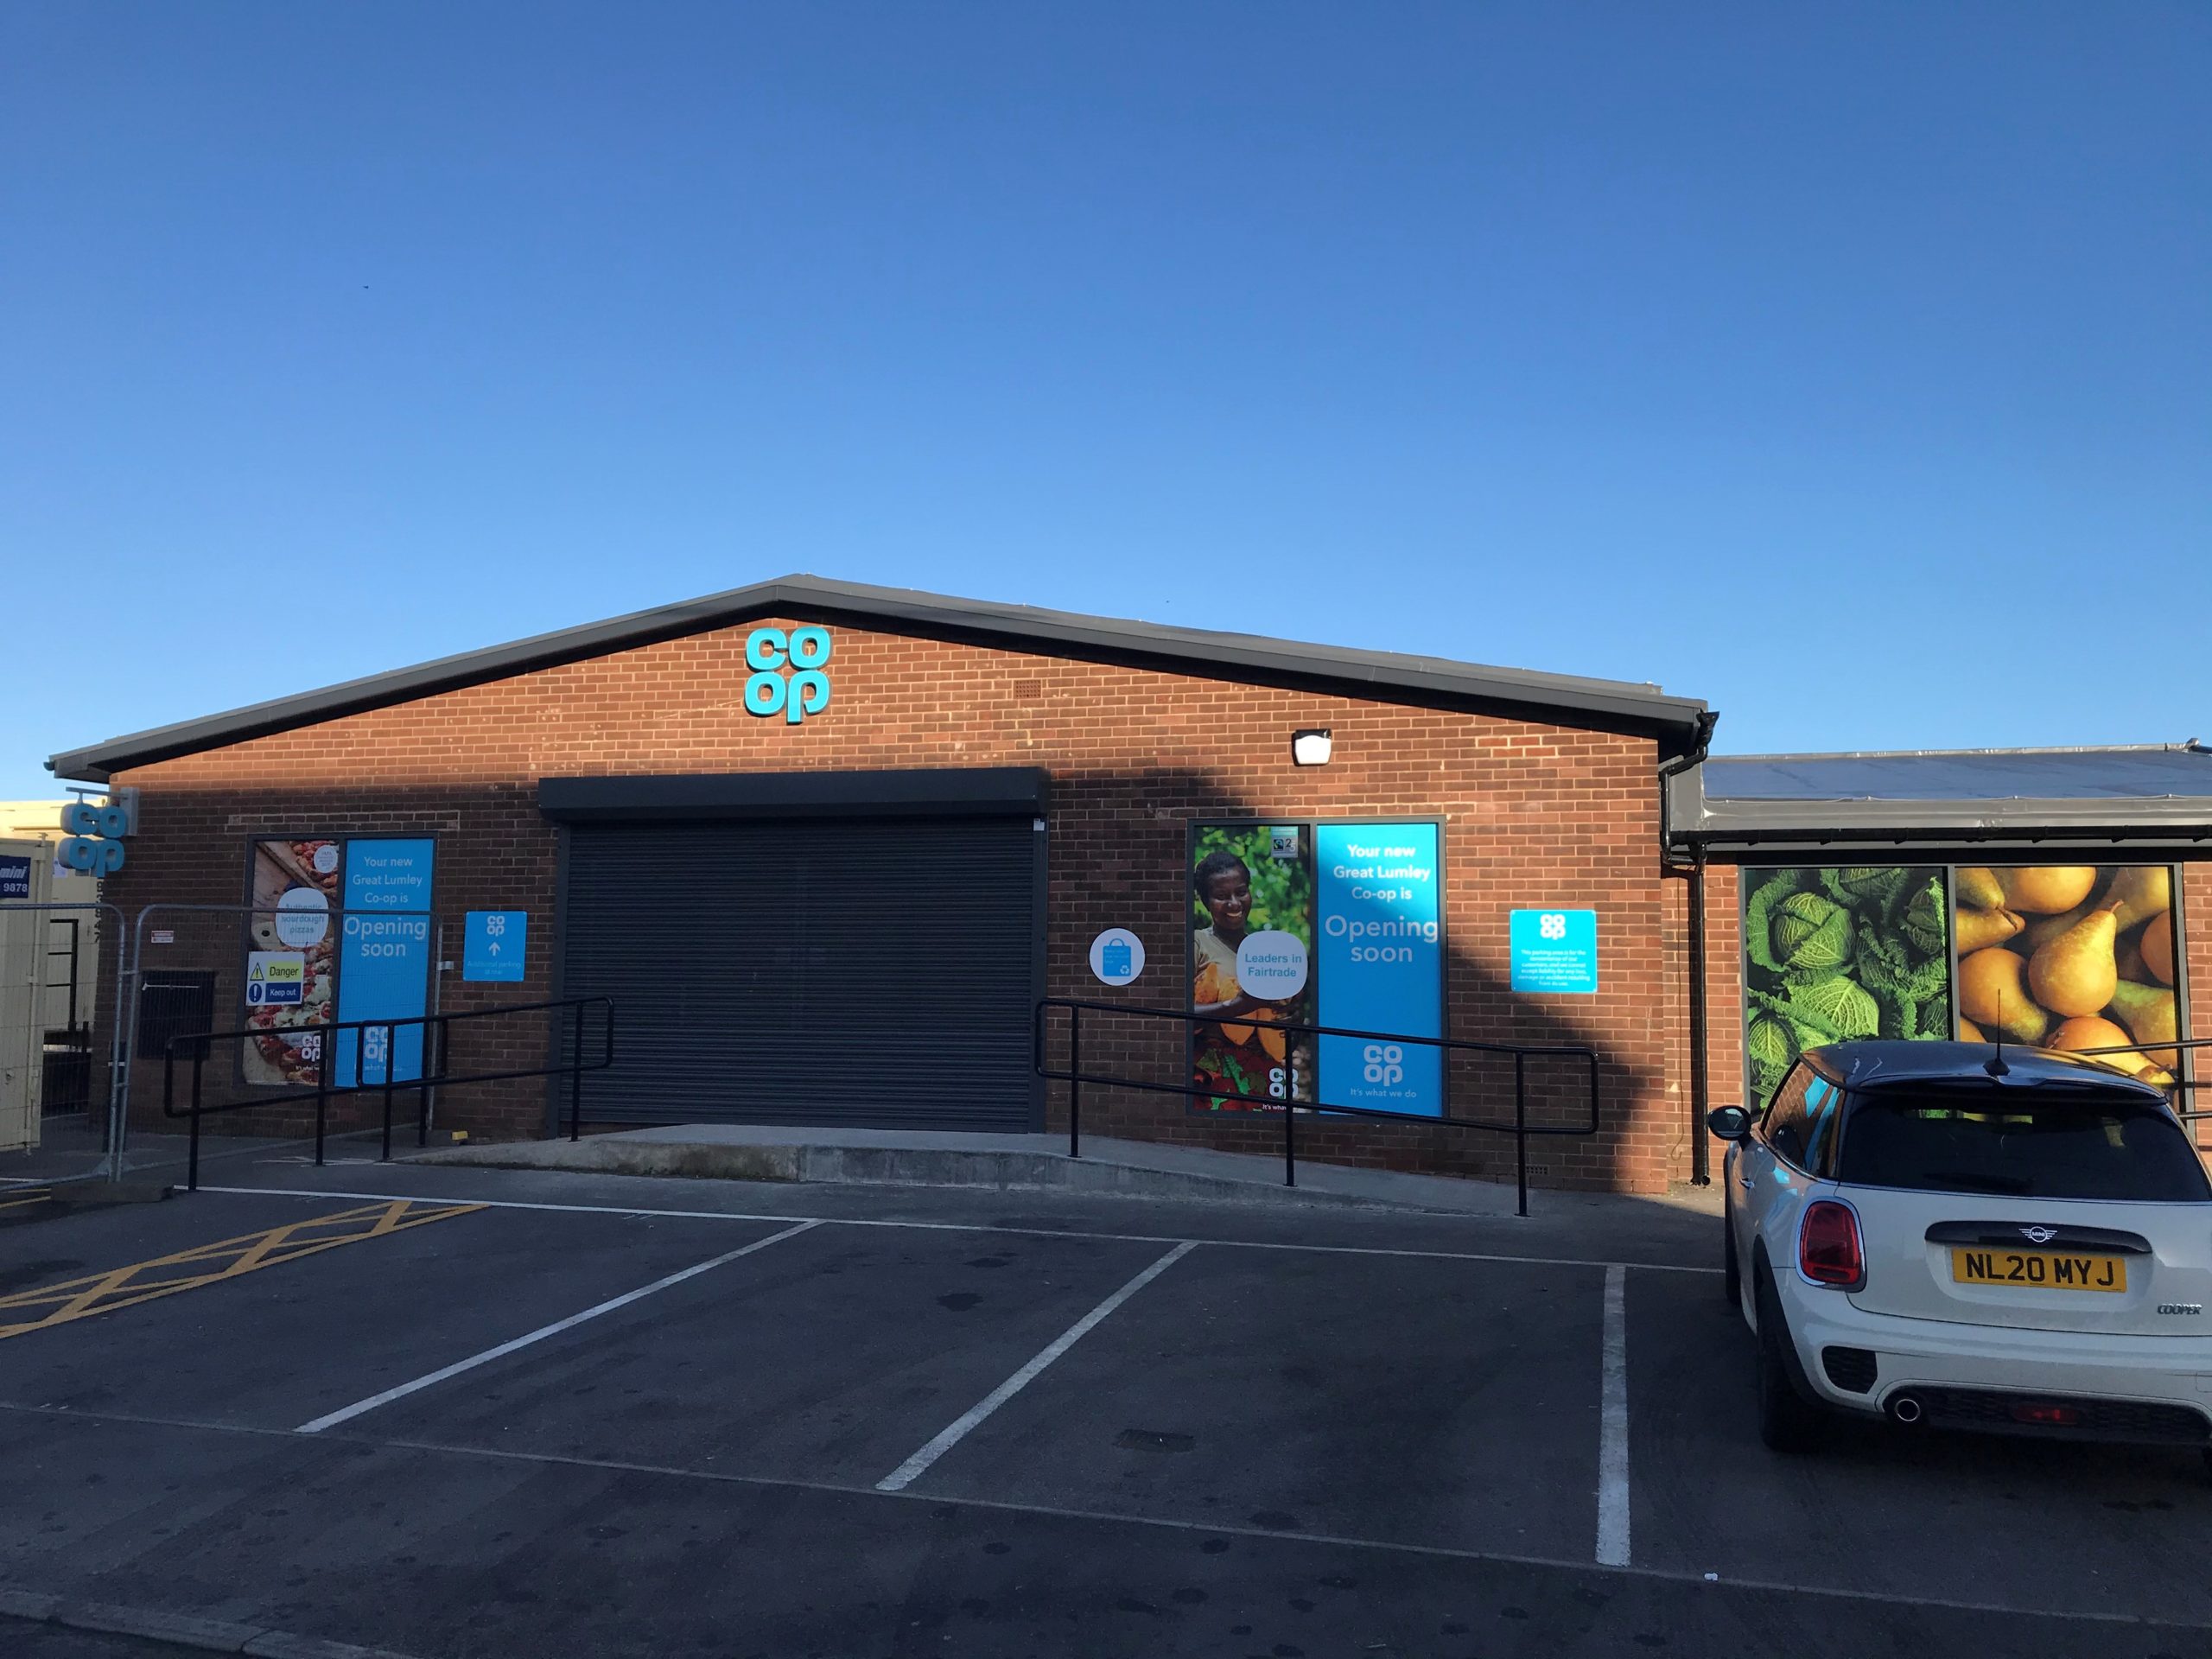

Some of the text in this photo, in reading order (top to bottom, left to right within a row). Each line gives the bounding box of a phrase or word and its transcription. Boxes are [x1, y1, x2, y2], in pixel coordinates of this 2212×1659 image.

[1347, 844, 1416, 858] Your new
[364, 856, 413, 868] Your new
[1333, 864, 1431, 882] Great Lumley
[353, 874, 423, 887] Great Lumley
[3, 882, 28, 893] 9878
[365, 892, 409, 906] Co-op is
[1351, 886, 1413, 903] Co-op is
[289, 925, 315, 934] pizzas
[344, 917, 427, 941] Opening
[1325, 914, 1439, 944] Opening
[361, 943, 406, 957] soon
[1351, 946, 1414, 963] soon
[1245, 954, 1302, 963] Leaders in
[270, 966, 299, 978] Danger
[1248, 967, 1297, 977] Fairtrade
[270, 988, 285, 997] Keep
[1351, 1087, 1363, 1096] It's
[1365, 1088, 1387, 1097] what
[1405, 1089, 1417, 1098] do
[1966, 1253, 2113, 1287] NL20 MYJ
[2157, 1302, 2202, 1315] COOPER
